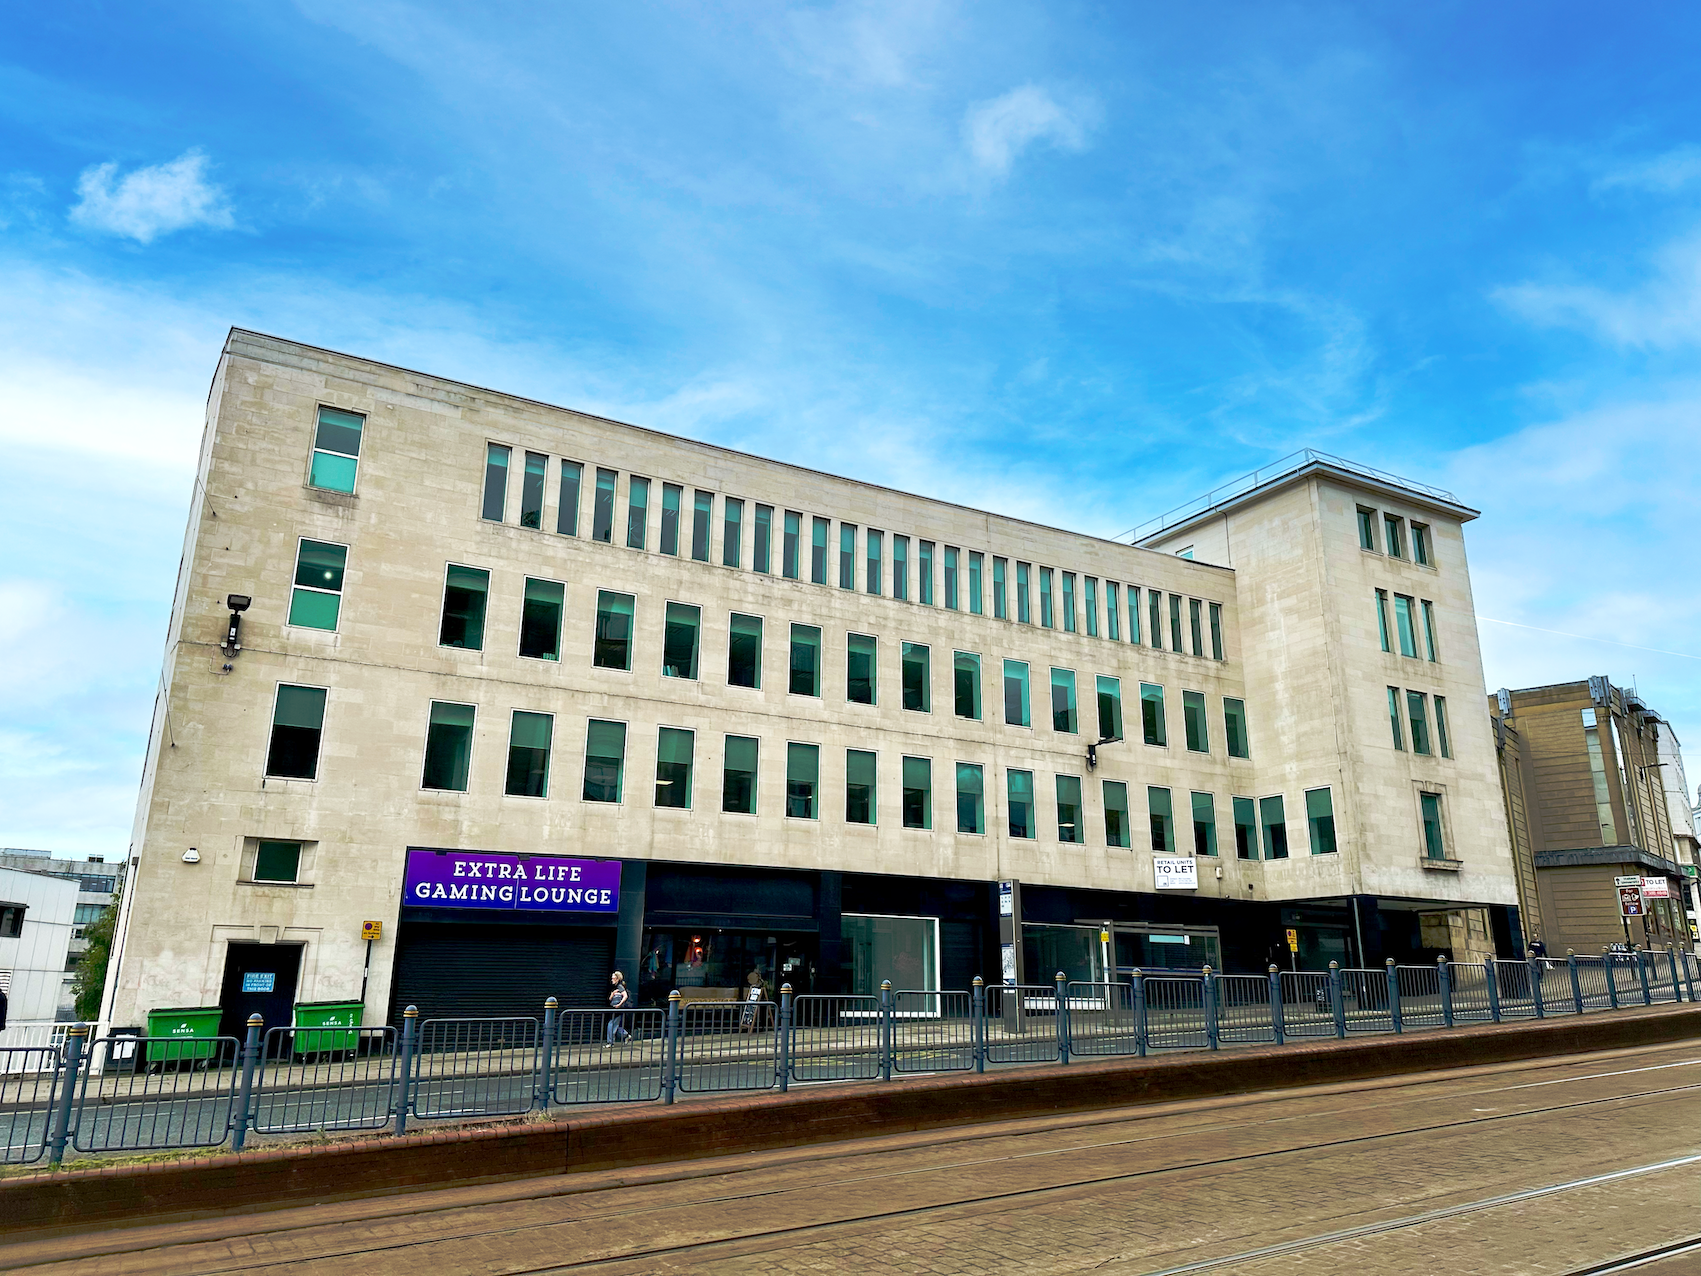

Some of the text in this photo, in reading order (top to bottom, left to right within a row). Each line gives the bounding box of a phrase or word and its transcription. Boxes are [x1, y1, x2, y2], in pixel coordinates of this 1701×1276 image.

[453, 861, 582, 882] EXTRA LIFE
[415, 882, 612, 905] GAMING LOUNGE
